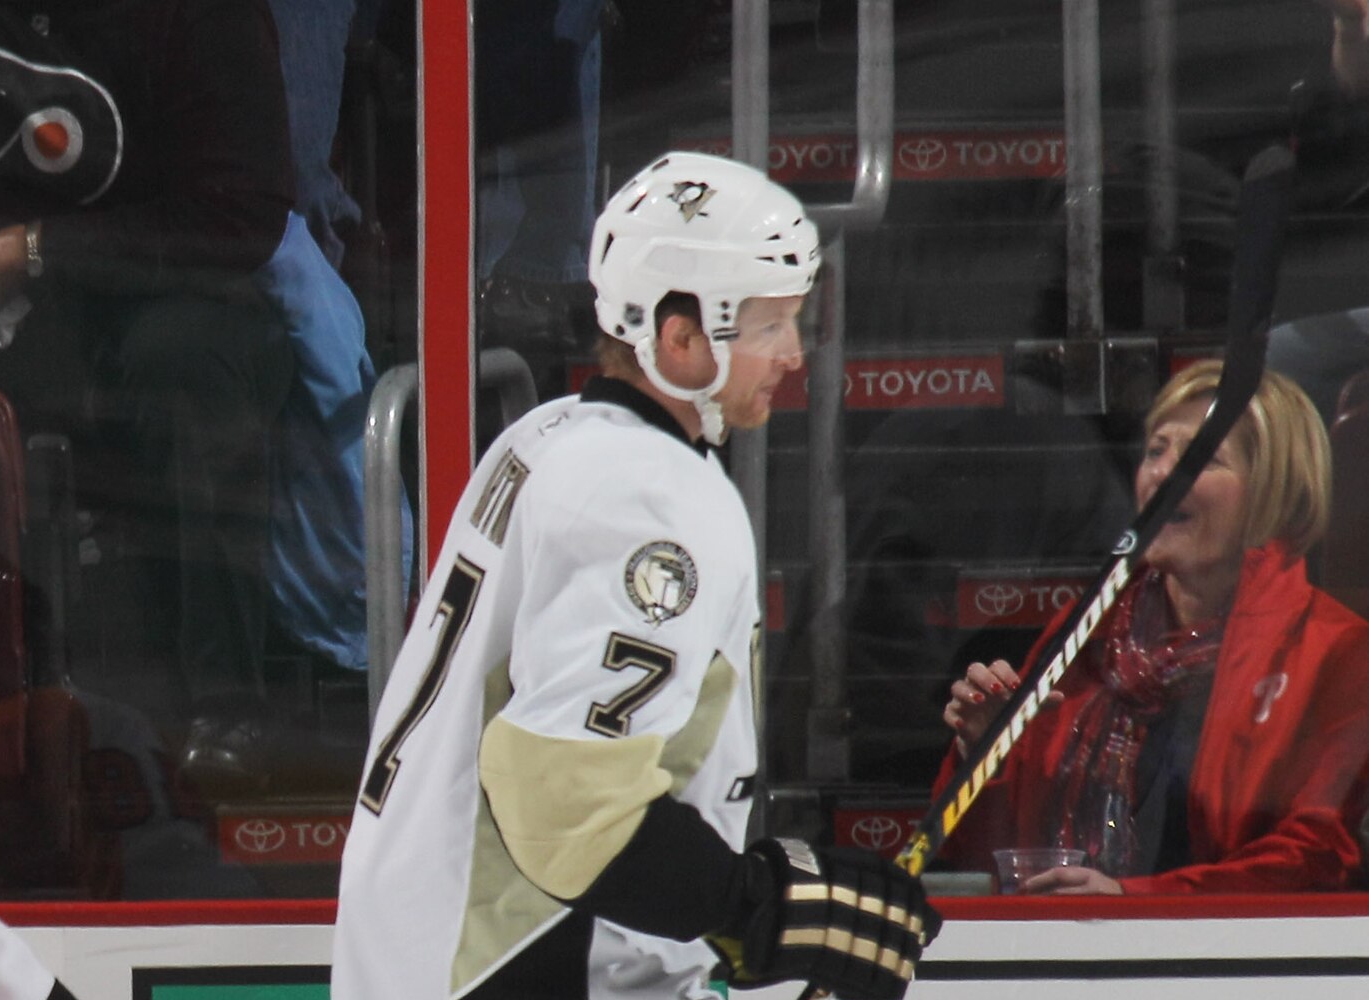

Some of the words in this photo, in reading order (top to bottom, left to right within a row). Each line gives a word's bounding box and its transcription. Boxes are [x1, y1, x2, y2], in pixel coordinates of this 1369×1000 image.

[767, 143, 859, 170] OYOT
[953, 139, 1067, 167] TOYOT
[858, 368, 996, 397] TOYOTA
[585, 631, 678, 739] 7
[942, 556, 1131, 838] WARRIOR
